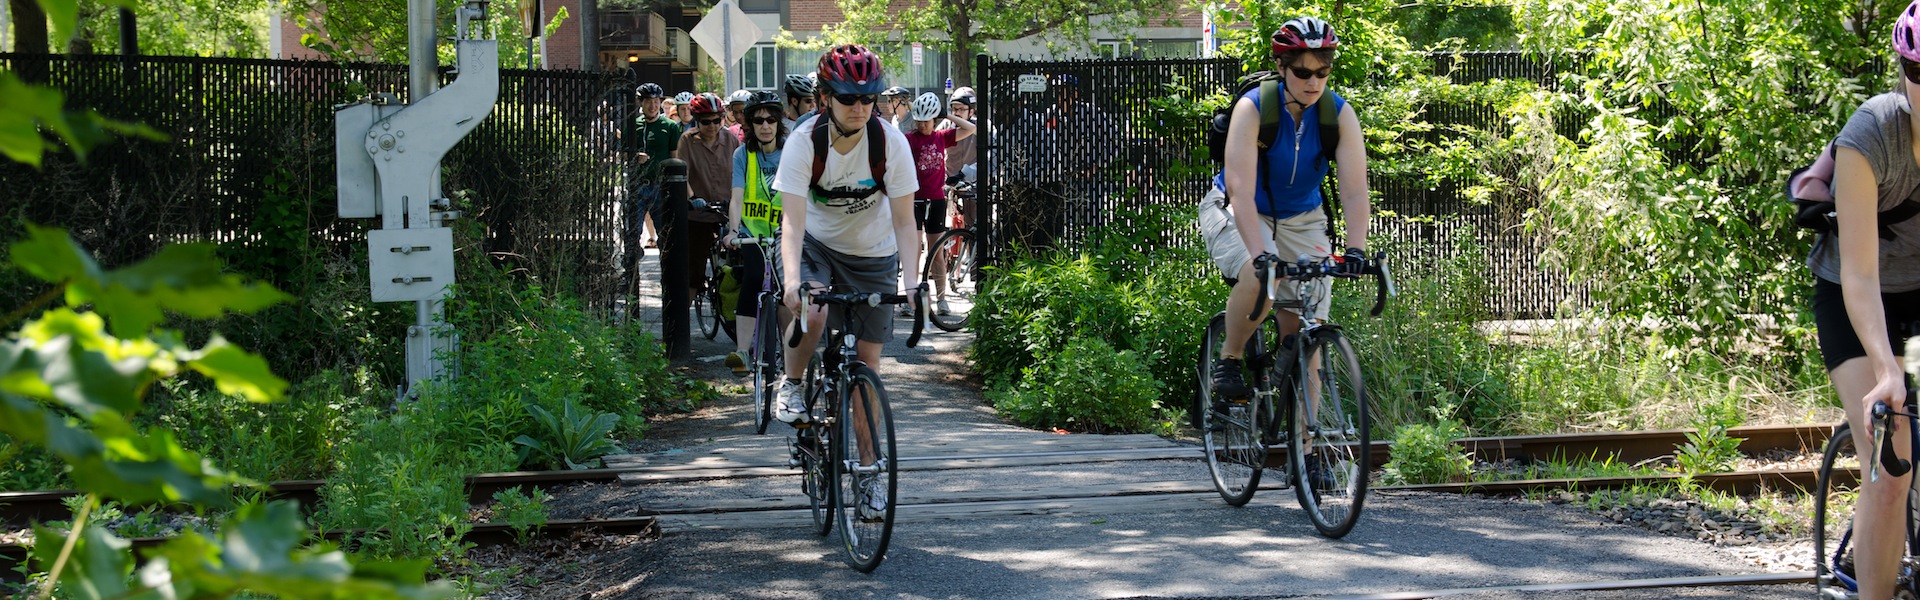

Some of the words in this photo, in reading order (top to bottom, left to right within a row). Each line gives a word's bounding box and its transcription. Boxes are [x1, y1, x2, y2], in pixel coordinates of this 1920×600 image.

[743, 201, 769, 218] TRAF
[770, 208, 783, 224] FI
[848, 200, 868, 210] MASS
